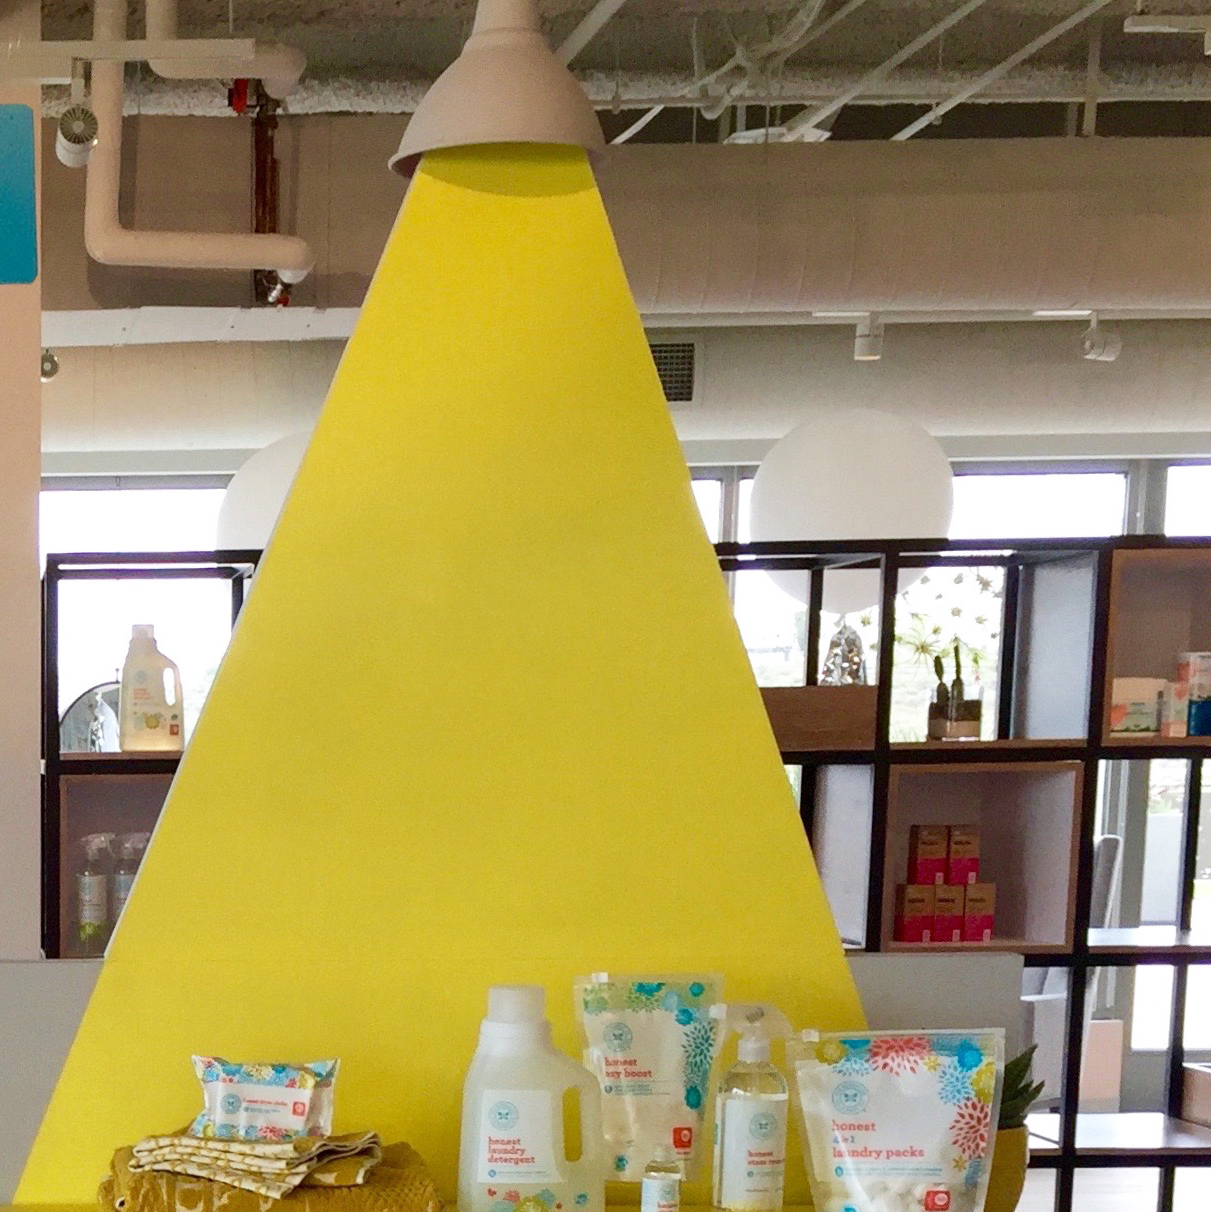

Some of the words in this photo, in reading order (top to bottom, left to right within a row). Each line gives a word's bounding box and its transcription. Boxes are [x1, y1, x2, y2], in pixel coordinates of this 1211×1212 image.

[604, 1056, 638, 1067] honest
[624, 1067, 653, 1078] boost
[832, 1119, 877, 1132] honest
[488, 1135, 521, 1146] honest
[488, 1145, 526, 1157] laundry
[885, 1146, 926, 1160] packs
[488, 1156, 536, 1166] detergent
